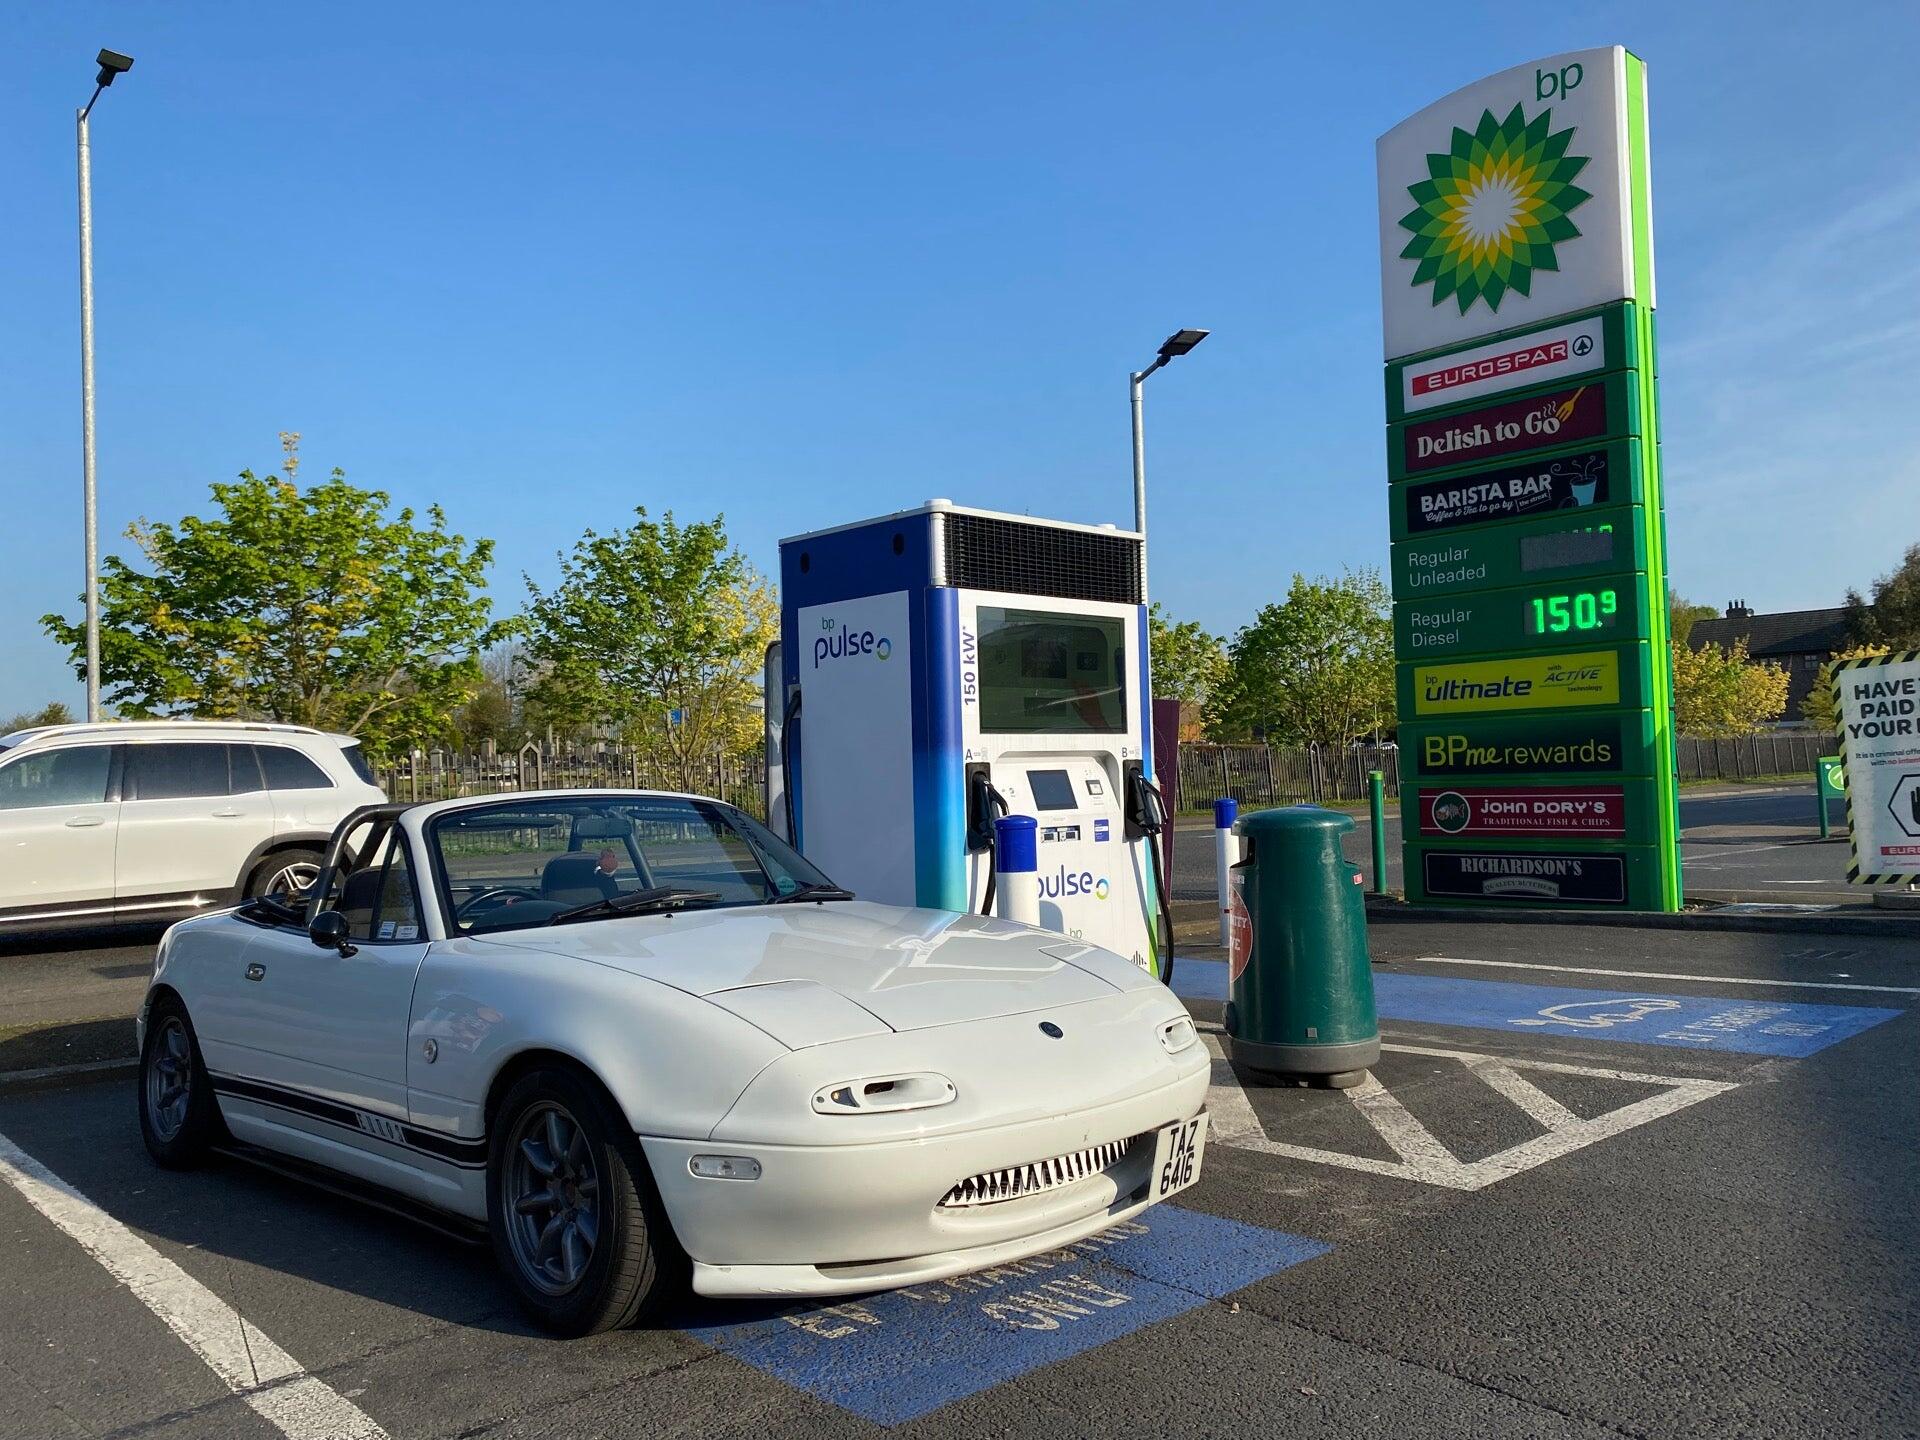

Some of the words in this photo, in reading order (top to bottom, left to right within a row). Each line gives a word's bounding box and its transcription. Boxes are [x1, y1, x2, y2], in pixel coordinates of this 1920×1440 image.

[1536, 63, 1584, 101] bp
[1428, 345, 1566, 389] EUROSPAR
[1417, 424, 1492, 458] Delish
[1496, 421, 1520, 441] to
[1525, 410, 1561, 435] Go
[1421, 482, 1504, 513] BARISTA
[1509, 474, 1552, 497] BAR
[1426, 510, 1454, 523] Coffee
[1479, 504, 1488, 513] to
[1489, 503, 1500, 514] go
[1502, 500, 1514, 511] by
[1409, 547, 1469, 568] Regular
[1409, 564, 1486, 587] Unleaded
[821, 616, 835, 633] bp
[1411, 609, 1472, 630] Regular
[814, 624, 875, 669] pulse
[1412, 630, 1459, 648] Diesel
[1425, 674, 1438, 685] bp
[1544, 669, 1601, 683] ACTIVE
[963, 671, 976, 706] 150
[1425, 676, 1532, 701] ultimate
[1854, 678, 1916, 701] HAVE
[1860, 698, 1915, 719] PAID
[1848, 718, 1913, 739] YOUR
[965, 748, 973, 761] A
[1121, 747, 1128, 758] B
[1504, 739, 1612, 765] rewards
[1533, 801, 1607, 814] DORY'S
[1483, 817, 1545, 825] TRADITIONAL
[1547, 818, 1569, 826] FISH
[1571, 818, 1579, 826] &
[1581, 818, 1611, 826] CHIPS
[1461, 857, 1583, 877] RICHARDSON'S
[1169, 1120, 1199, 1161] TAZ
[1160, 1151, 1195, 1196] 6416
[980, 1274, 1134, 1331] ONLY
